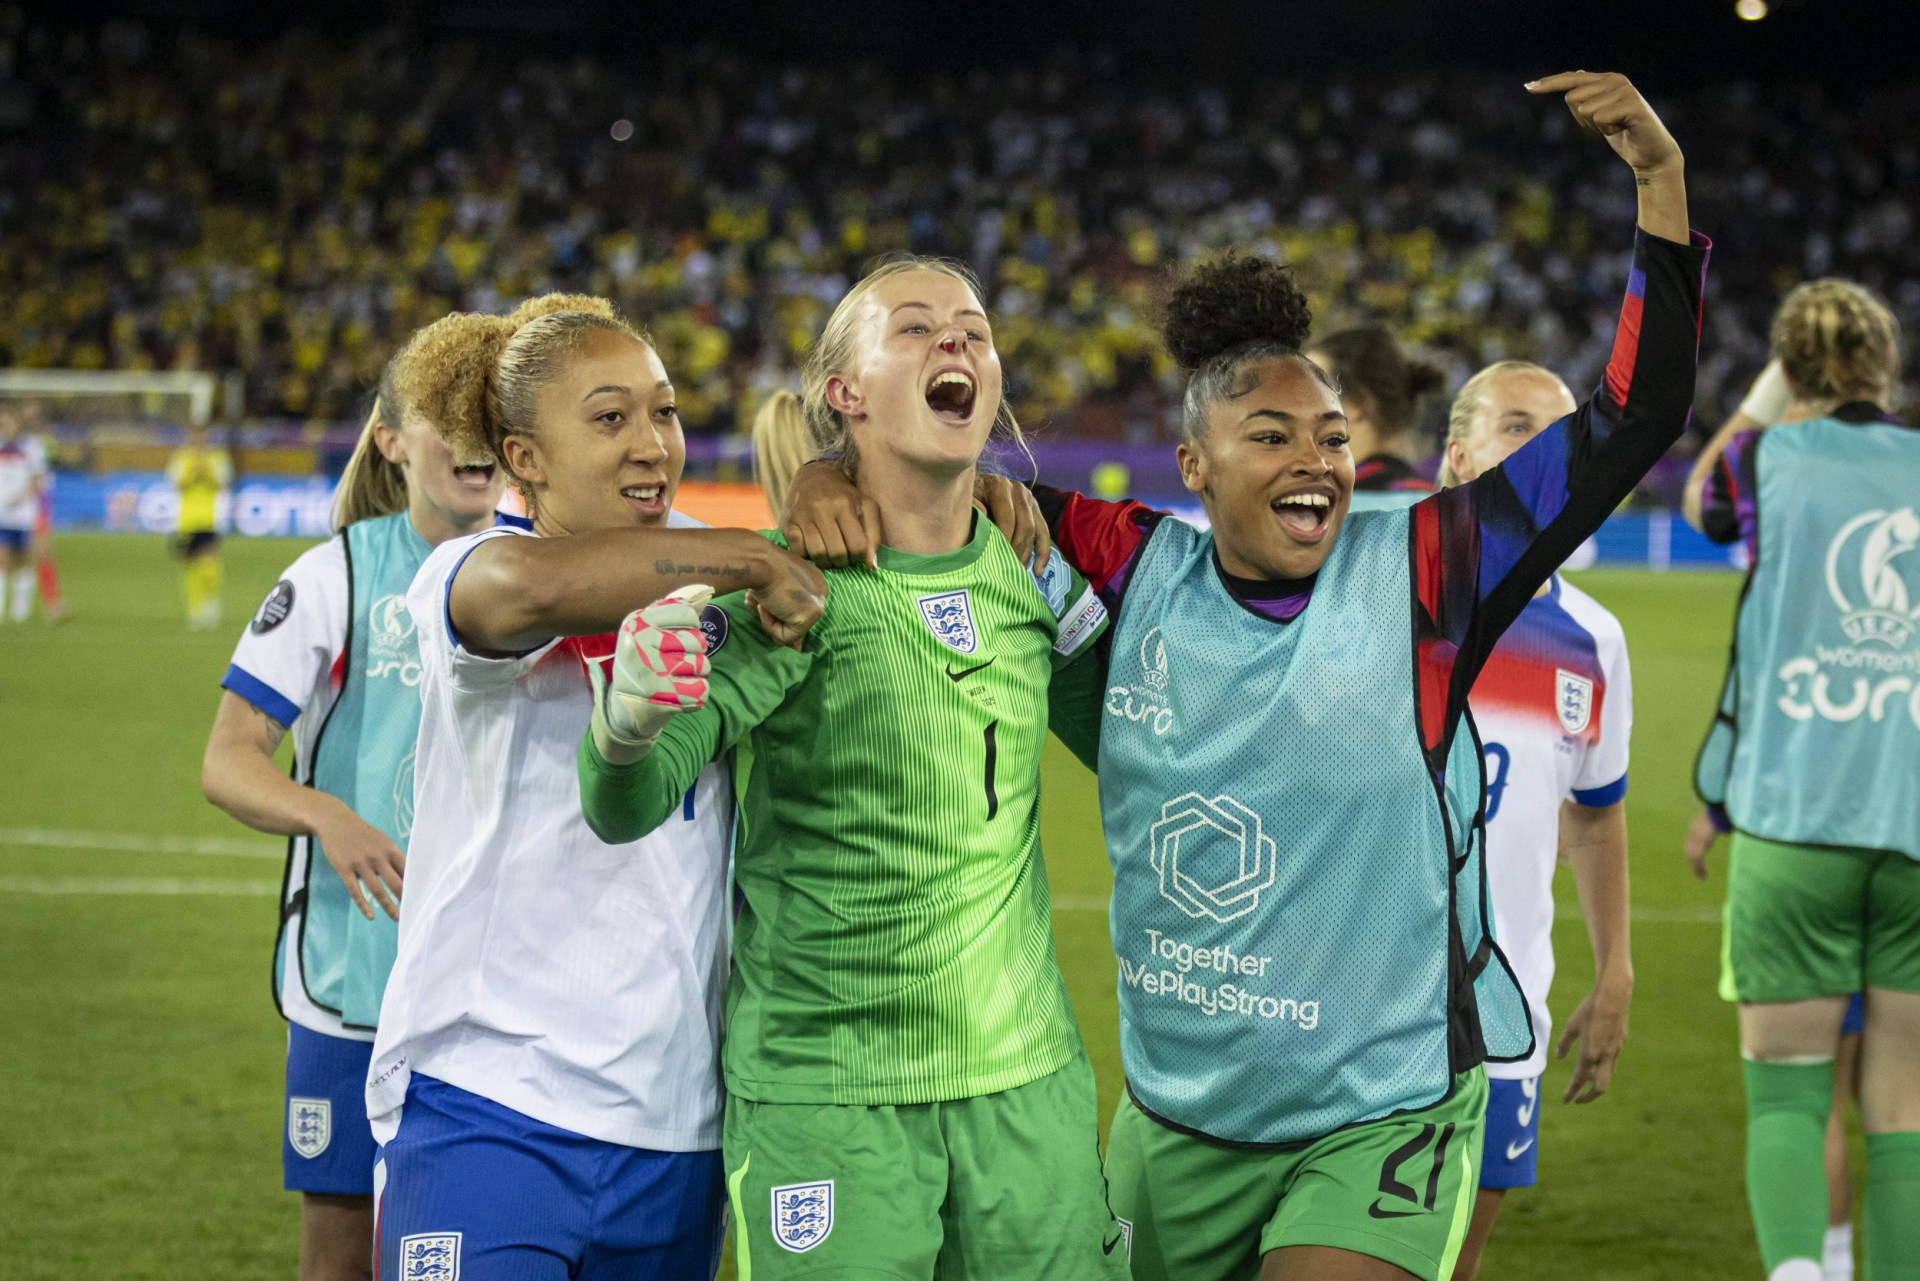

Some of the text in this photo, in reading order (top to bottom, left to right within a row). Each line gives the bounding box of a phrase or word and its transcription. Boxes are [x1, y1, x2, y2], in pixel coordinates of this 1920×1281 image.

[1054, 599, 1100, 649] FOUNDATION
[984, 719, 999, 821] 1
[1144, 928, 1272, 977] Together
[1119, 956, 1319, 1031] WePlayStrong
[1378, 1122, 1455, 1212] 21
